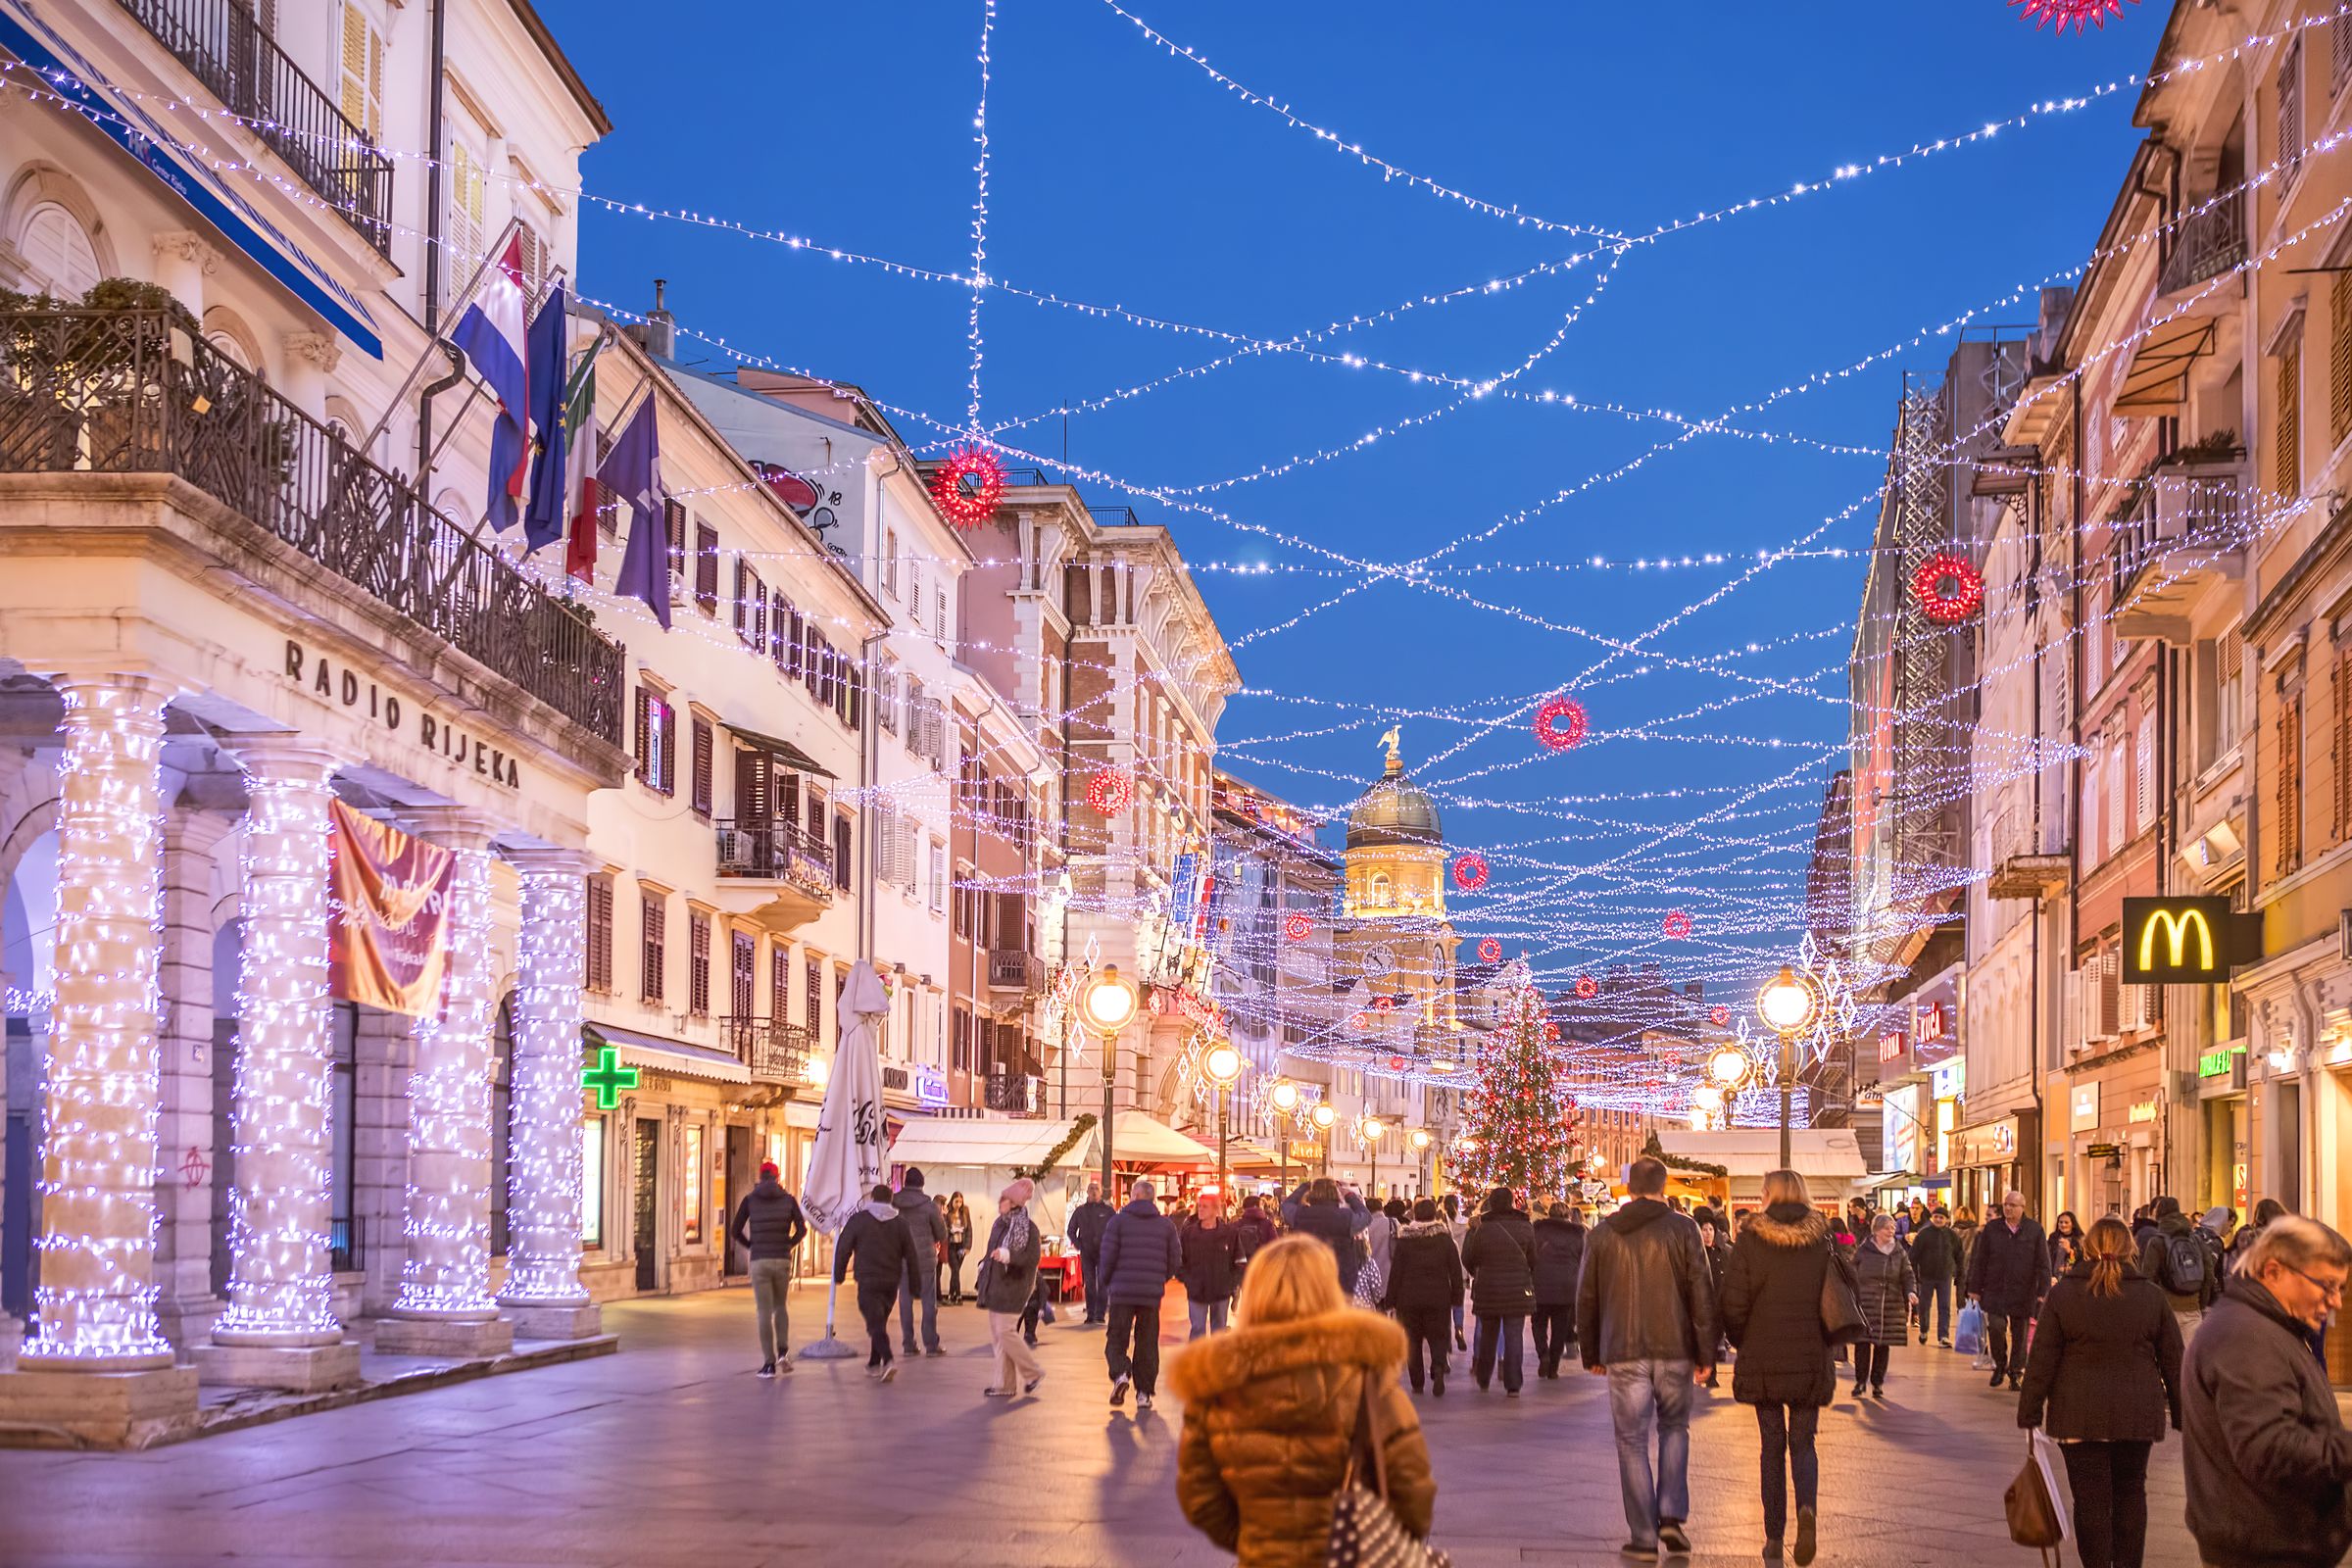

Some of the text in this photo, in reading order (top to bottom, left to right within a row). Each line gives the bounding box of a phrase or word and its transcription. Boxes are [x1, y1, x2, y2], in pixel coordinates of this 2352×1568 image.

[828, 491, 842, 506] 18
[286, 640, 519, 789] RADIO RIJEKA
